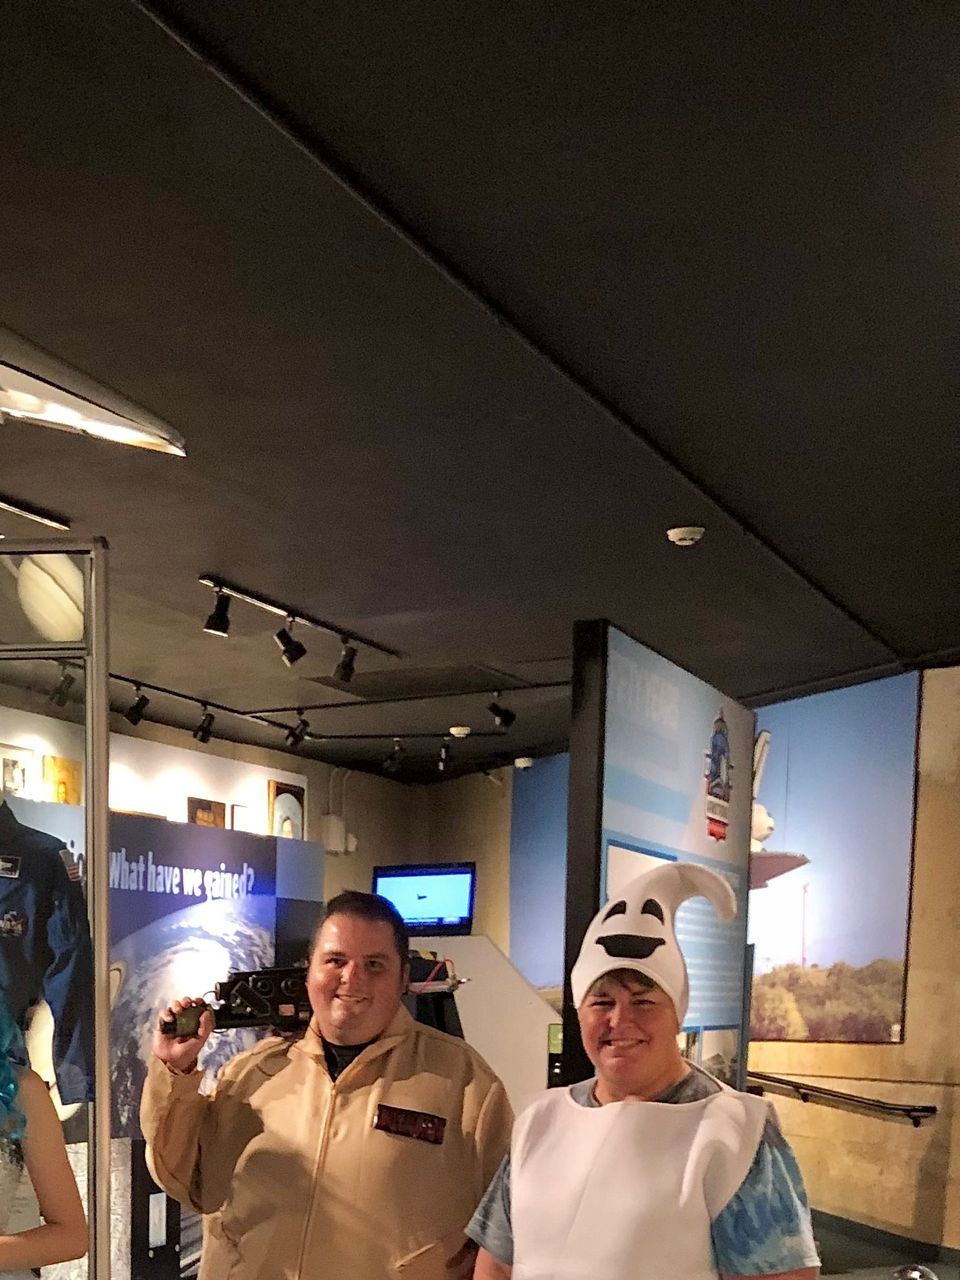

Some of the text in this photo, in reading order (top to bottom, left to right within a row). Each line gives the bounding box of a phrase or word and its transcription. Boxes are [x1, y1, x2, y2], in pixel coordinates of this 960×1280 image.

[108, 847, 145, 890] What
[147, 851, 180, 894] have
[182, 867, 203, 897] we
[204, 862, 255, 901] gained?
